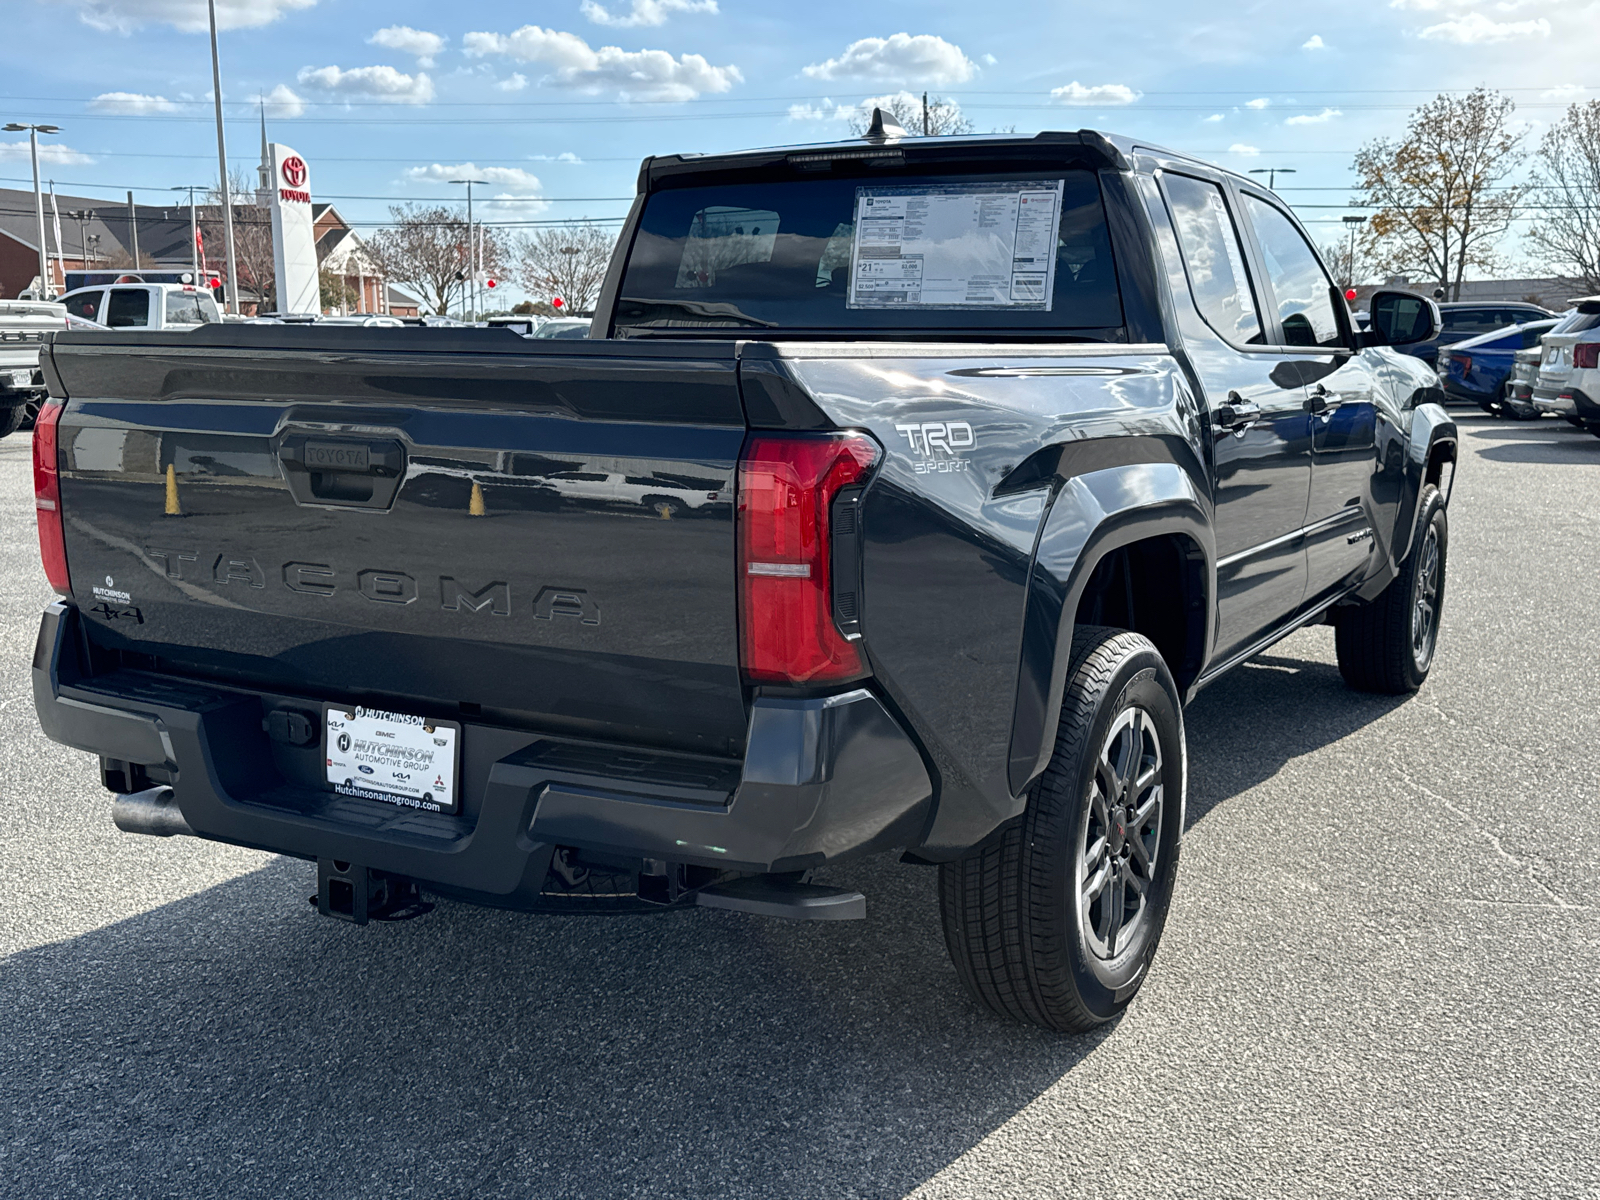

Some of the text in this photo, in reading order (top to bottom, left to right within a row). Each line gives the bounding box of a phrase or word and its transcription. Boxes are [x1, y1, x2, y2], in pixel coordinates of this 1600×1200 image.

[279, 188, 311, 204] TOYOTA
[861, 263, 872, 272] 21
[894, 421, 975, 456] TRD
[307, 447, 364, 466] TOYOTA
[914, 459, 971, 474] SPORT
[93, 587, 131, 599] HUTCHINSON
[145, 545, 601, 626] TACOMA
[365, 708, 425, 726] HUTCHINSON
[375, 730, 396, 739] GMC
[353, 739, 434, 764] HUTCHINSON
[354, 753, 430, 772] AUTOMOTIVE GROUP
[358, 765, 374, 774] Ford
[335, 783, 440, 812] Hutchinsonautogroup.com
